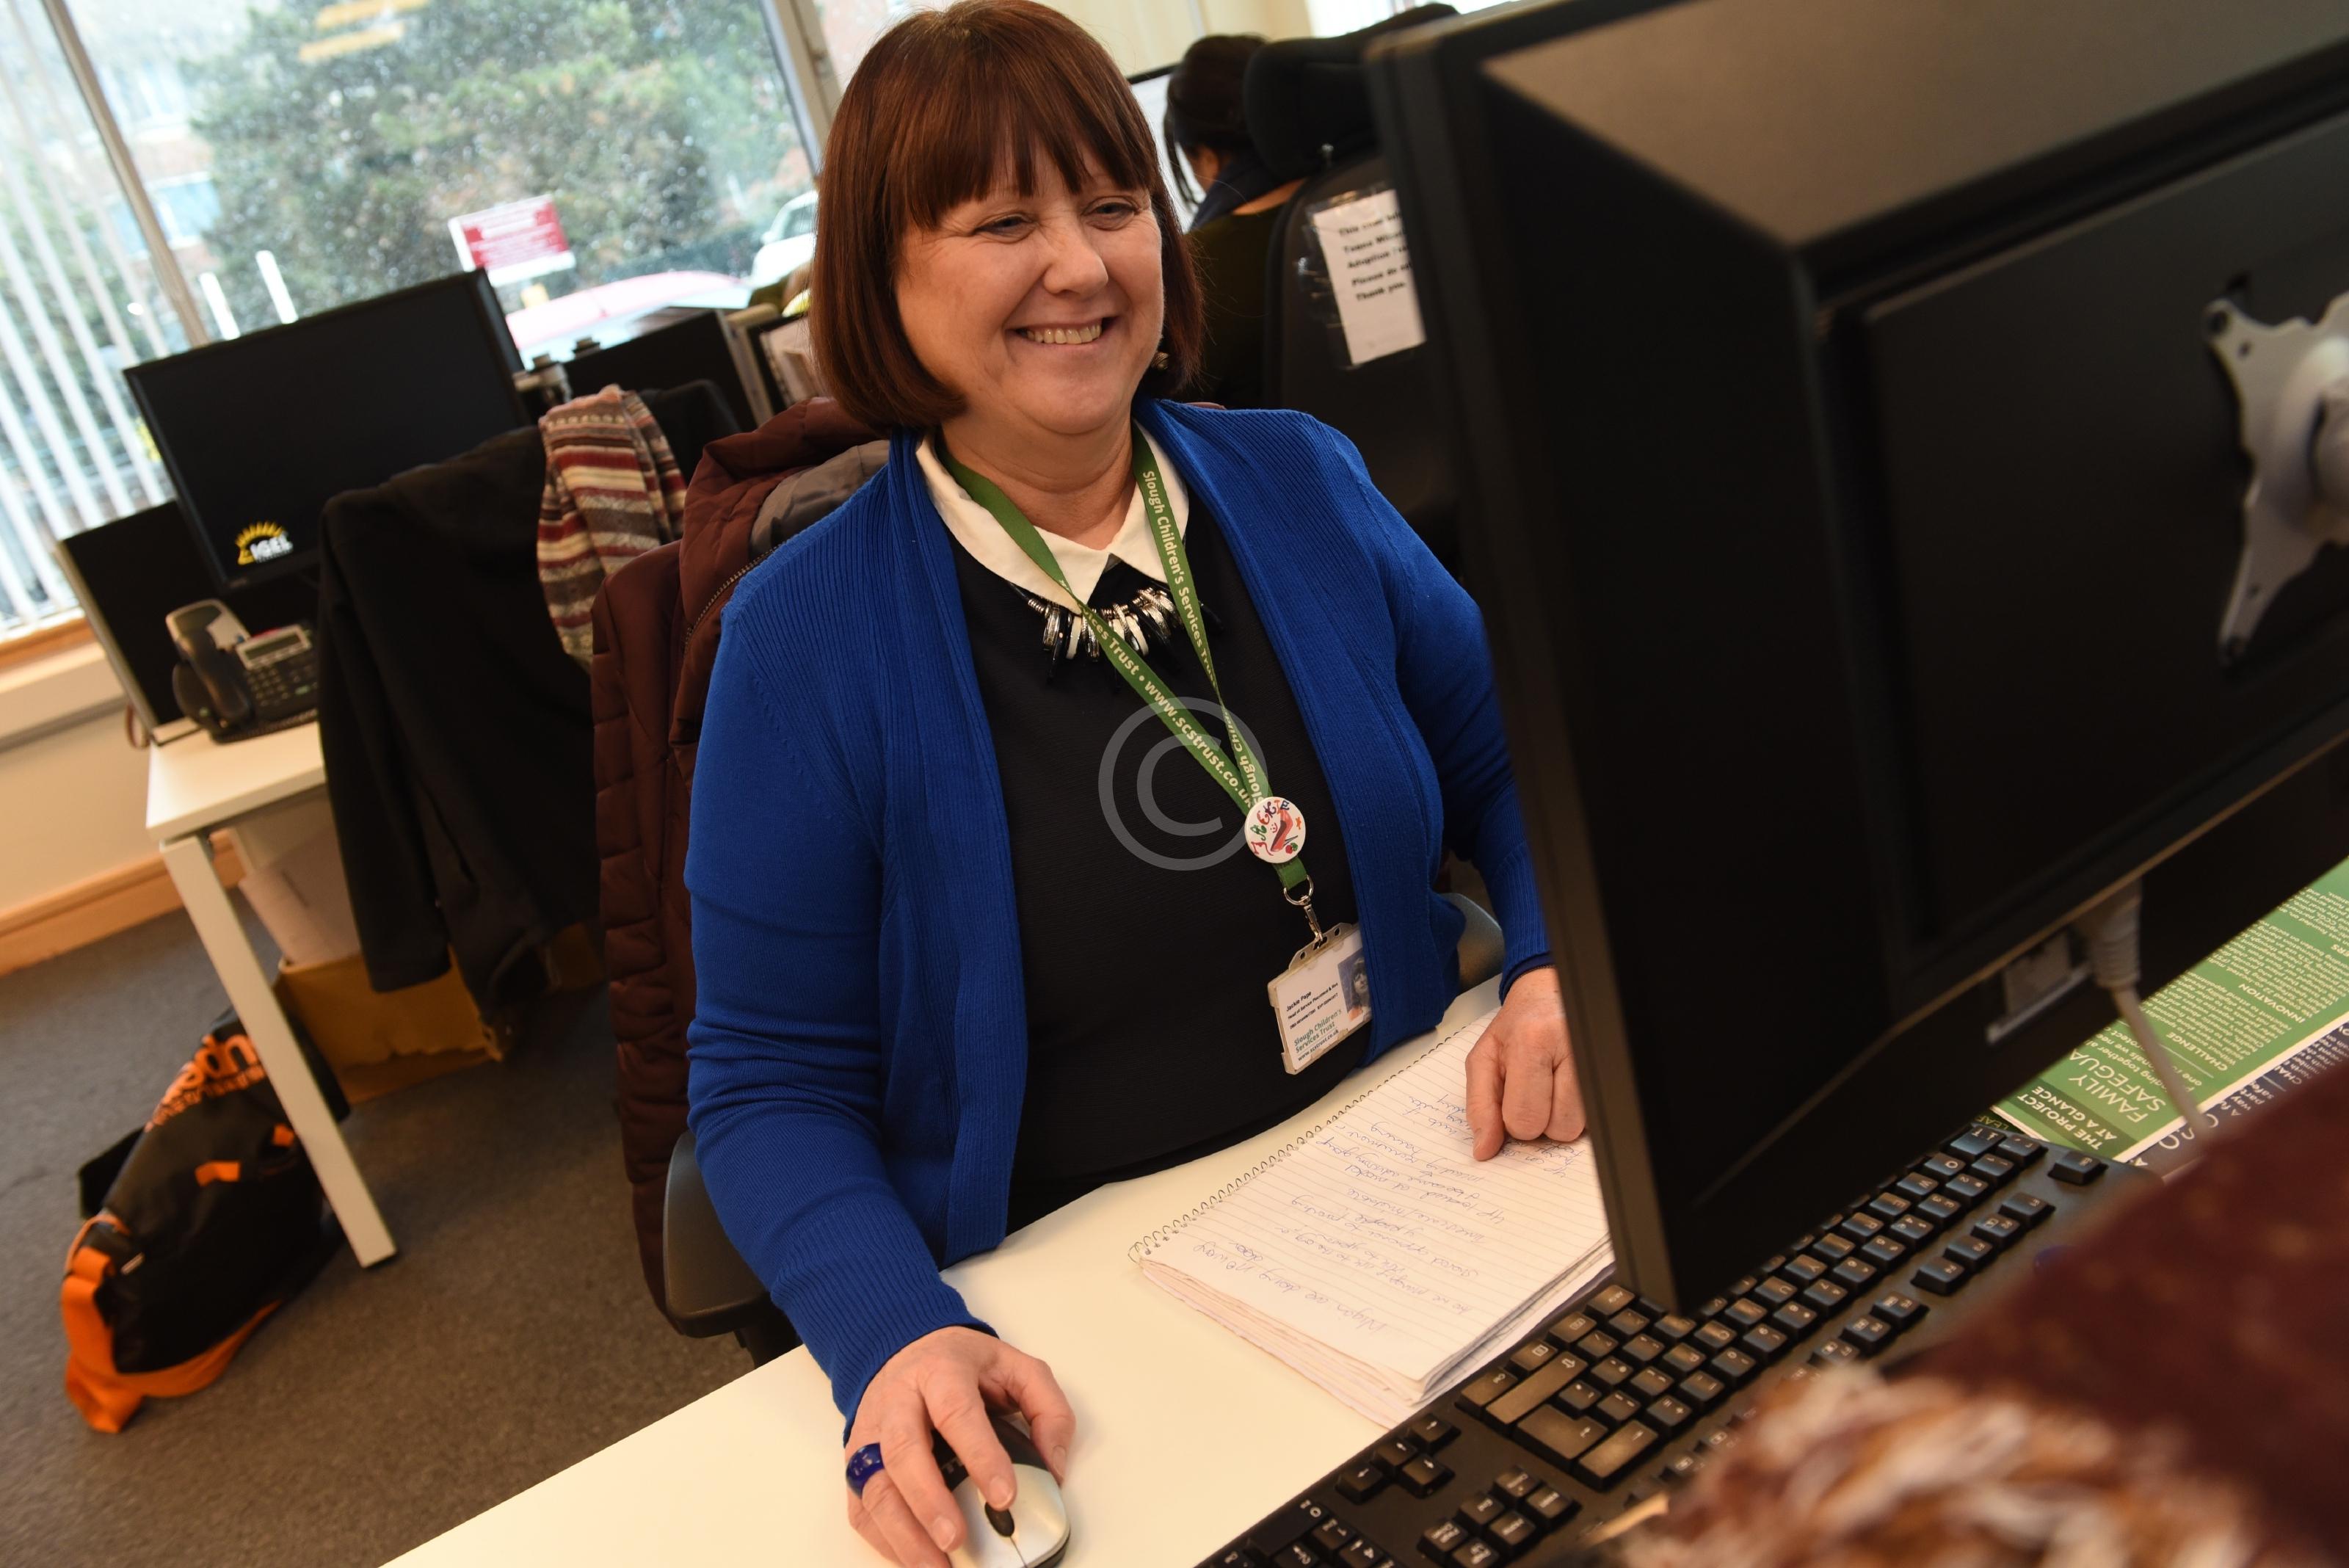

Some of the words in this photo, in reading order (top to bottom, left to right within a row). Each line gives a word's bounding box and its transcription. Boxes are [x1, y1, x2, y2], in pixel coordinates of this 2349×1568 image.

[250, 531, 294, 559] IGEL
[1142, 470, 1166, 513] Slough
[1157, 515, 1185, 585] Children's
[1178, 587, 1202, 648] Services
[1109, 637, 1140, 675] Trust
[2251, 972, 2297, 1000] Safeguarding
[1286, 1000, 1300, 1012] Jackie
[1301, 992, 1311, 1001] Pape
[2168, 1006, 2186, 1017] from
[2181, 1005, 2201, 1017] abuse
[2182, 998, 2209, 1015] workers
[2202, 1001, 2234, 1021] expertise
[2238, 983, 2306, 1023] INNOVATION
[2296, 998, 2320, 1015] Family
[2145, 1009, 2177, 1028] specialist
[2152, 1005, 2177, 1020] cannot
[2207, 1013, 2229, 1026] social
[1294, 1028, 1313, 1046] Slough
[1314, 1009, 1341, 1031] Children's
[2176, 1018, 2196, 1031] alone
[2185, 1015, 2214, 1034] children
[2201, 1016, 2233, 1037] domestic
[1295, 1034, 1319, 1053] Services
[1320, 1021, 1335, 1035] Trust
[2185, 1031, 2209, 1046] access
[2196, 1029, 2223, 1048] workers
[2222, 1037, 2243, 1051] harm
[2114, 1044, 2130, 1053] we
[2165, 1031, 2228, 1071] CHALLENGE
[2207, 1045, 2236, 1066] Without
[2222, 1046, 2244, 1060] social
[2096, 1046, 2141, 1072] together
[2182, 1072, 2202, 1086] one
[2031, 1086, 2085, 1121] GLANCE
[2068, 1074, 2149, 1123] FAMILY
[2017, 1094, 2077, 1131] PROJECT
[2086, 1119, 2099, 1128] A
[2074, 1128, 2102, 1150] THE
[2095, 1128, 2117, 1140] AT
